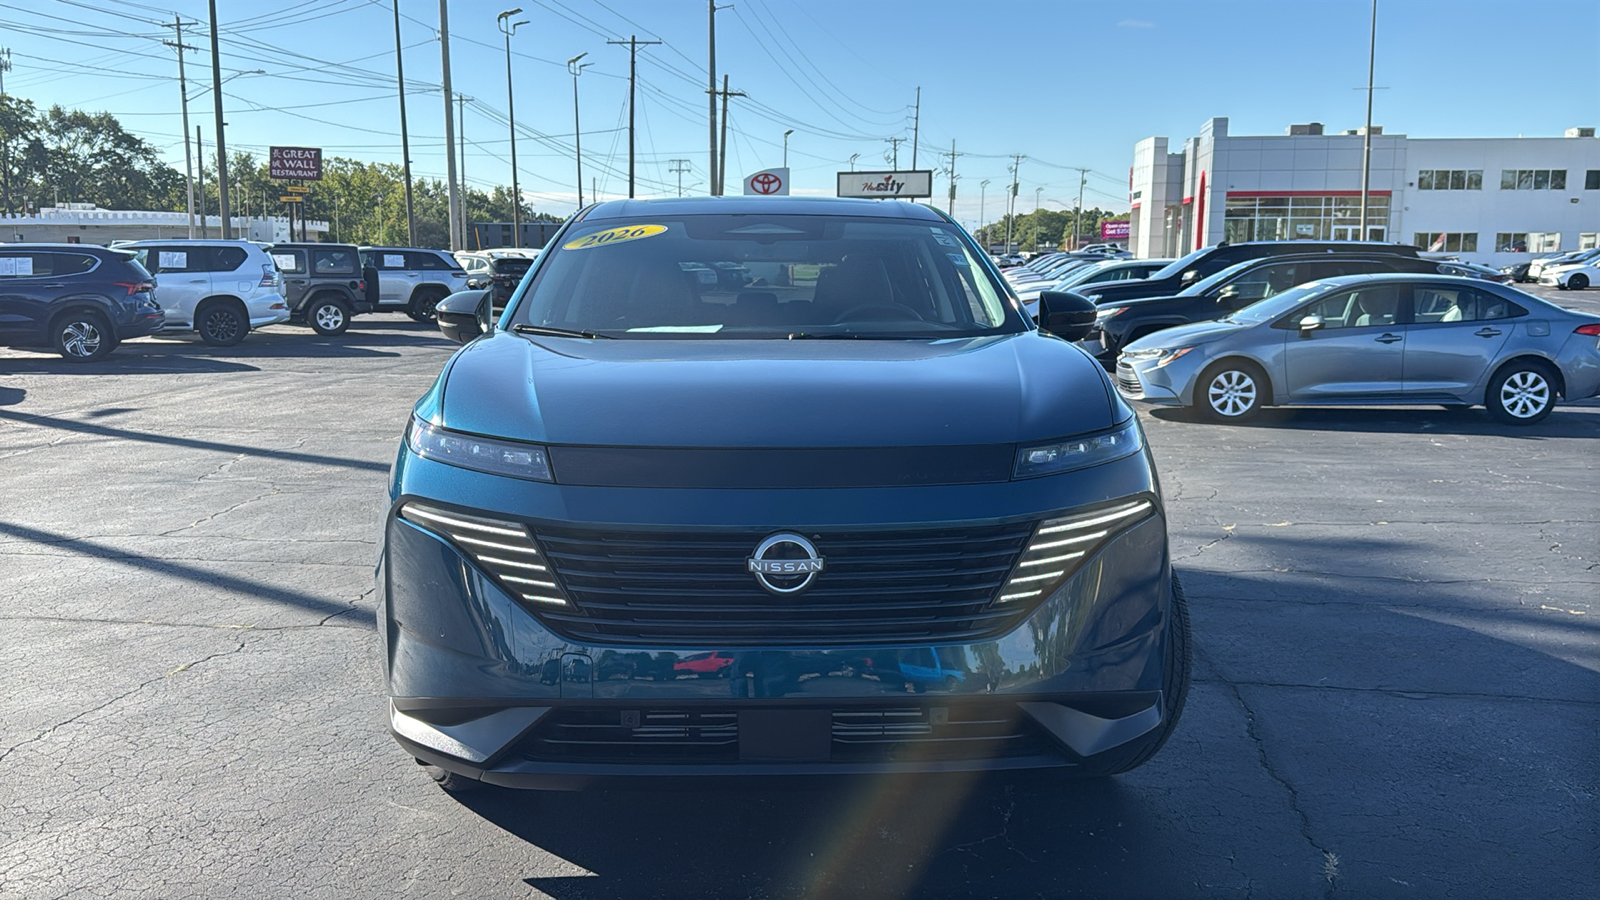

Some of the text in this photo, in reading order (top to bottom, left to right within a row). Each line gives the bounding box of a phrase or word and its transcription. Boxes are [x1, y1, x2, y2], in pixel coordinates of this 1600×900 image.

[282, 150, 317, 159] GREAT
[283, 160, 316, 169] WALL
[271, 169, 318, 177] RESTAURANT
[579, 226, 649, 247] 2026
[750, 561, 822, 572] NISSAN
